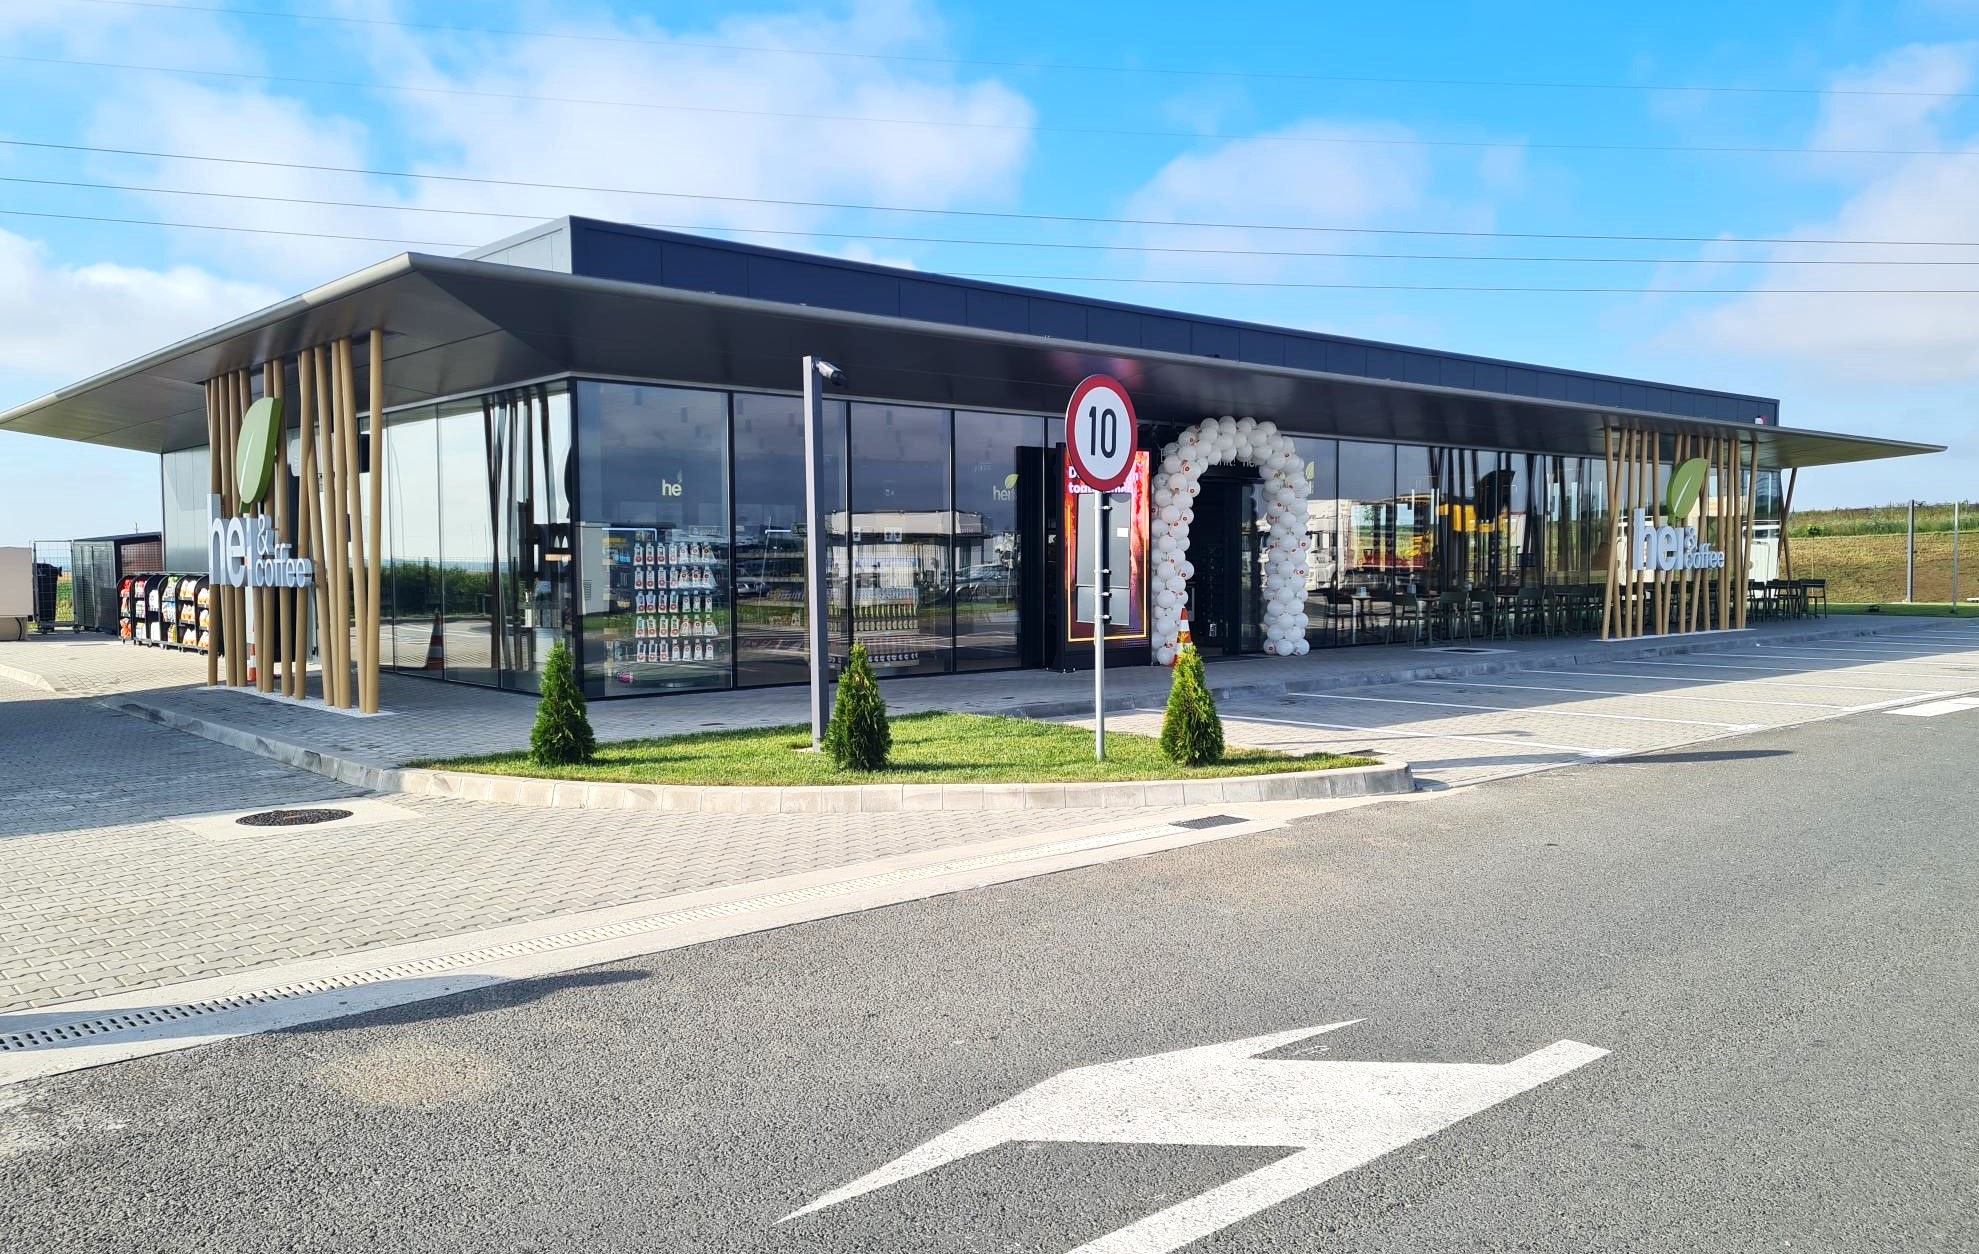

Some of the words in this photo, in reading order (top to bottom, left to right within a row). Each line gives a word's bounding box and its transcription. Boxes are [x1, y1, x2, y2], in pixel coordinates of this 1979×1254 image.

[1089, 406, 1117, 458] 10
[207, 494, 253, 587] hei
[257, 514, 269, 555] &
[1633, 508, 1684, 570] hei
[1684, 543, 1725, 569] coffee
[255, 543, 306, 587] coffee
